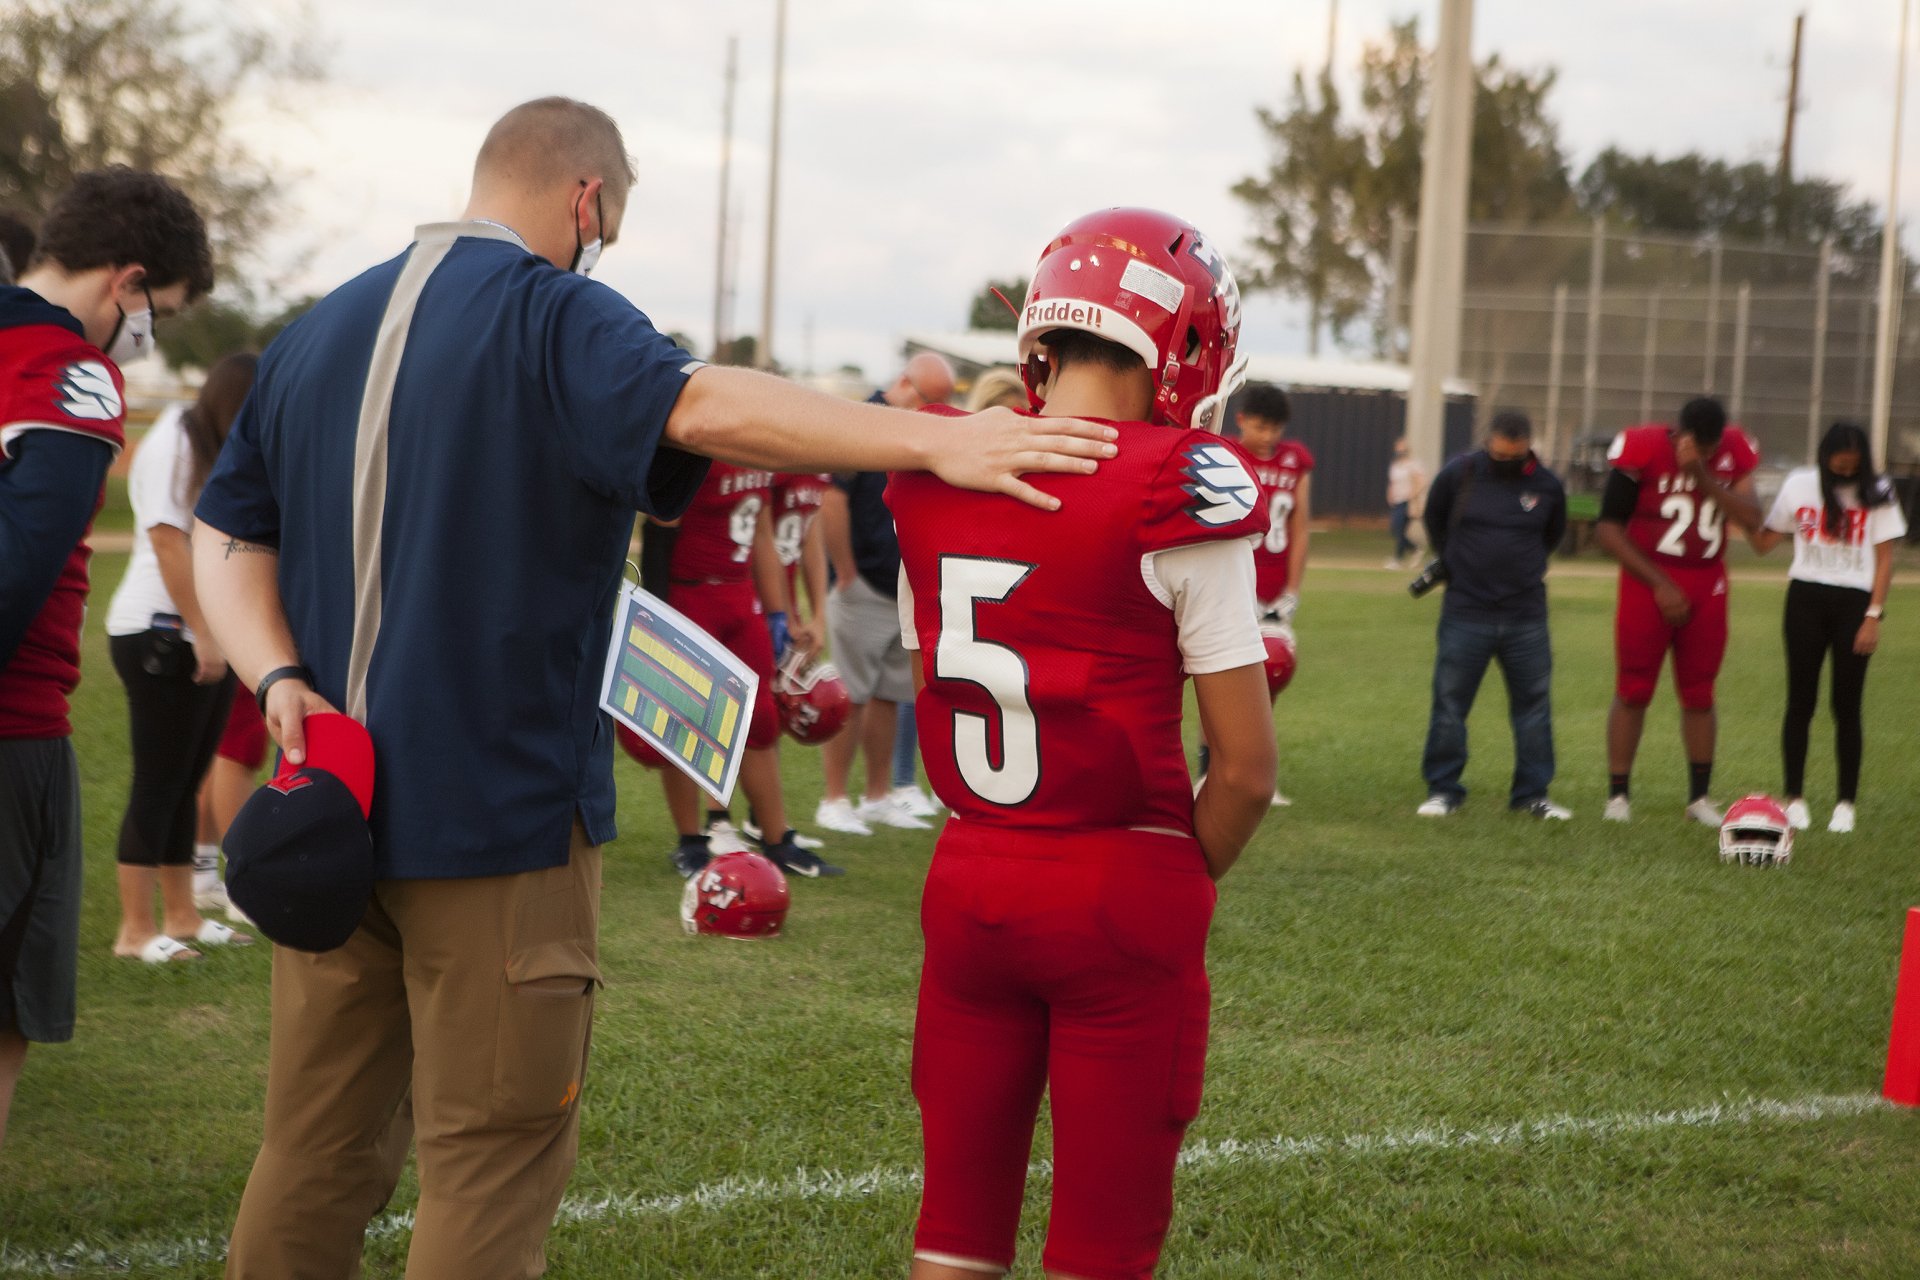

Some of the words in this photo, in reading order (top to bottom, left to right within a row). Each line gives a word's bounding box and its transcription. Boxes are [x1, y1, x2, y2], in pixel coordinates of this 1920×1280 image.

[1026, 302, 1102, 328] Riddell
[1655, 494, 1725, 559] 29
[936, 552, 1040, 806] 5
